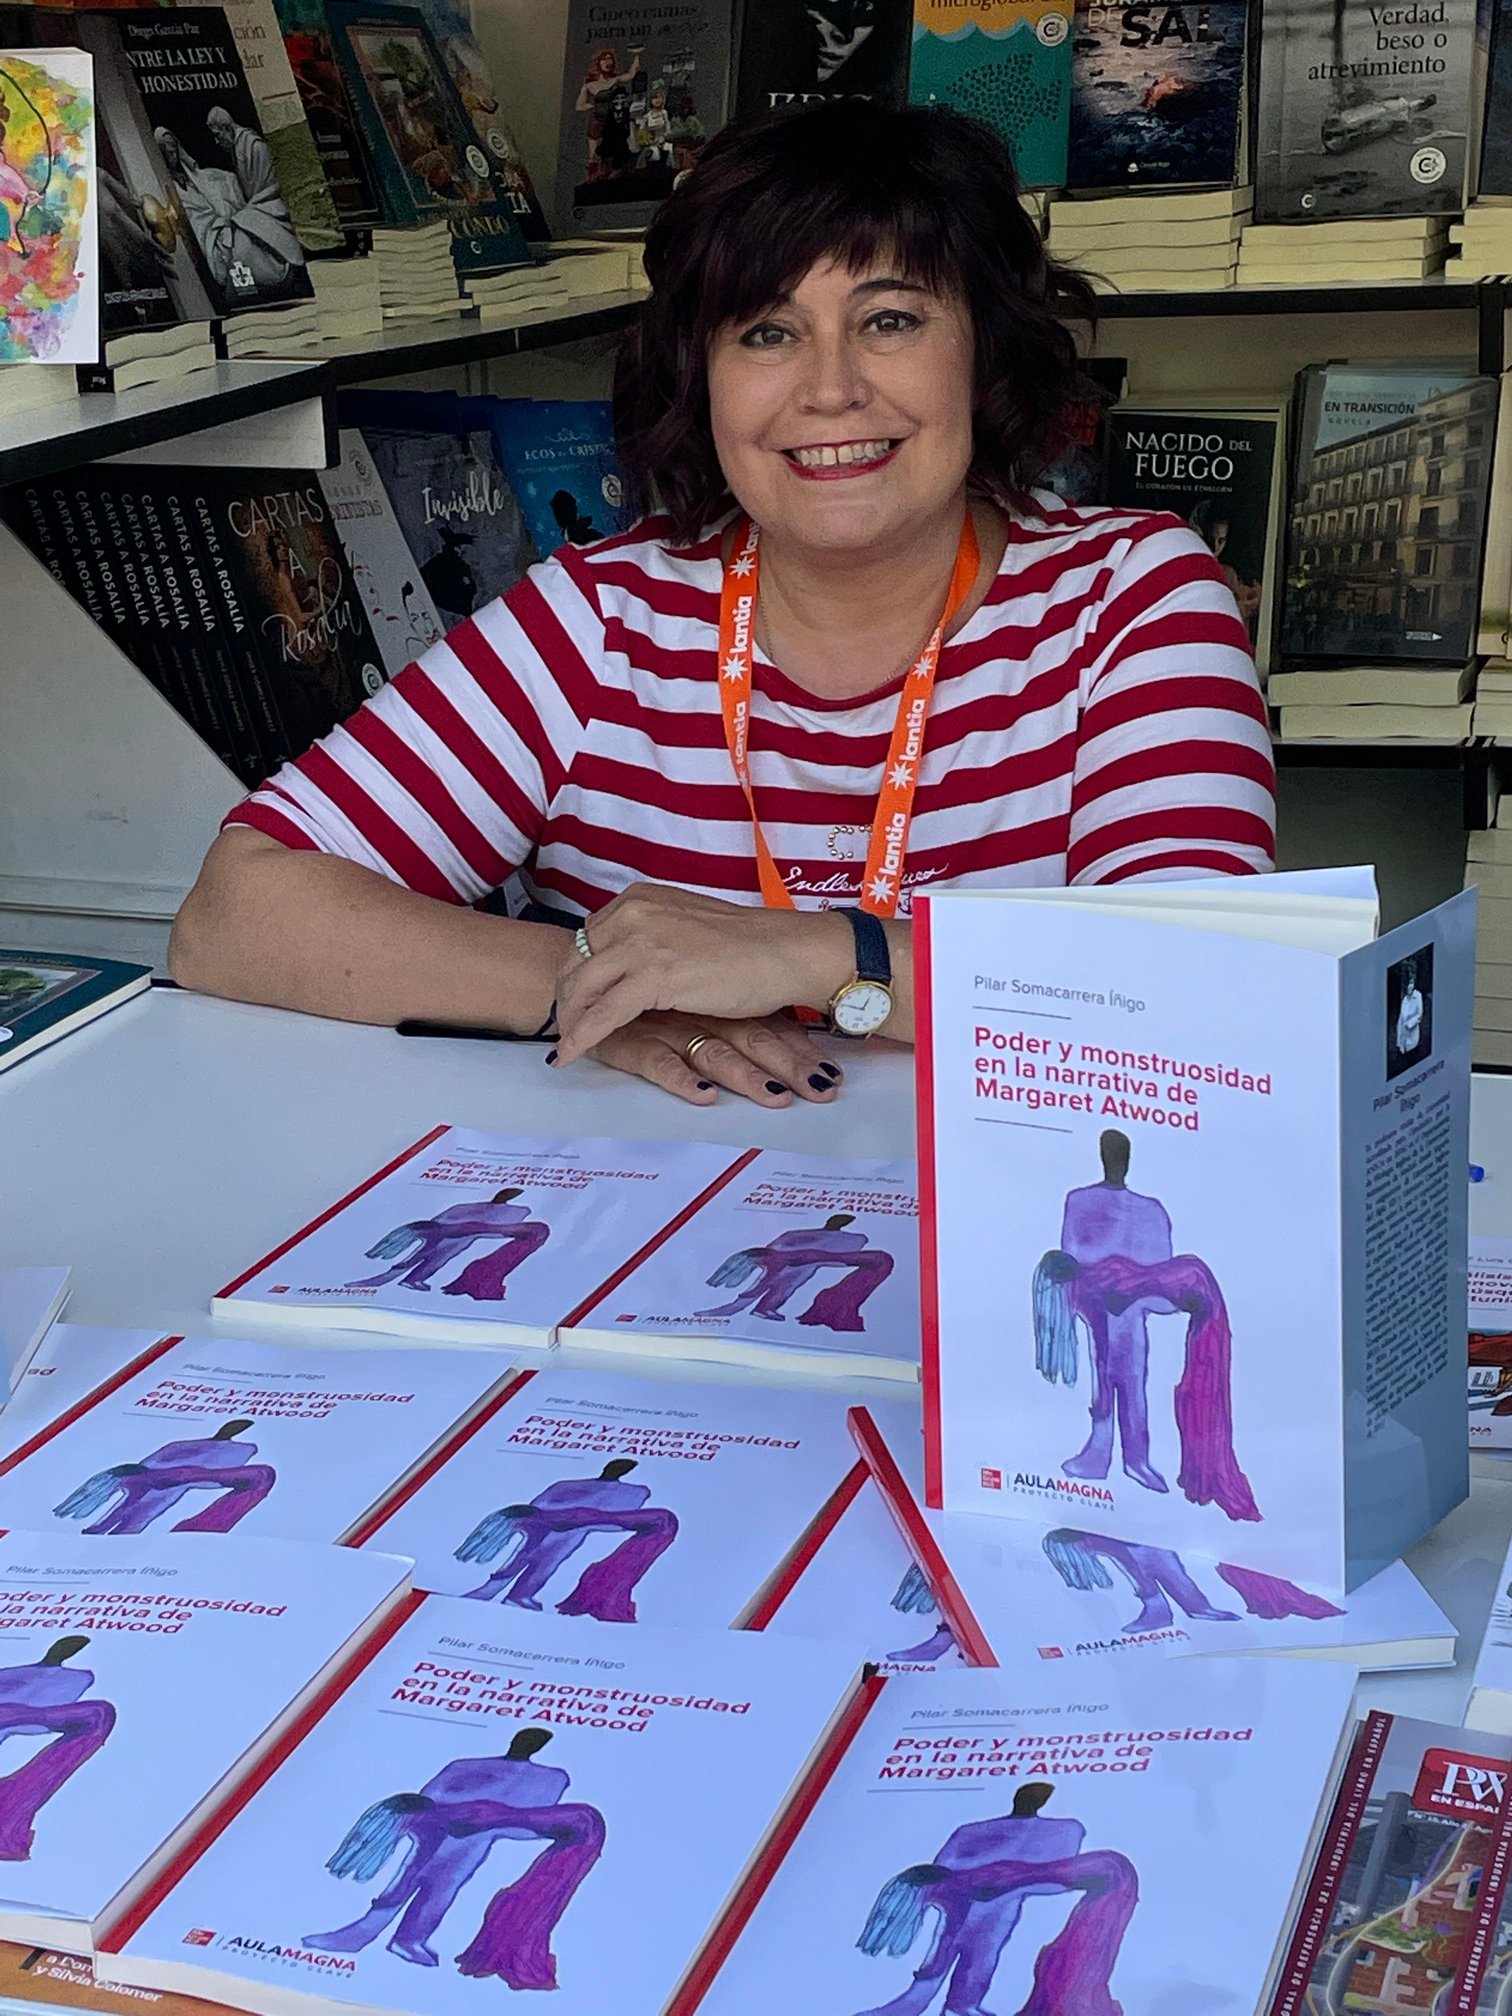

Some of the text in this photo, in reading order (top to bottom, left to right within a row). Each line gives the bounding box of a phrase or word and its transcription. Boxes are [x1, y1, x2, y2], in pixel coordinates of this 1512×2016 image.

[1376, 30, 1448, 51] beso o
[1308, 55, 1446, 81] atrevimiento
[140, 71, 238, 94] HONESTIDAD
[1324, 400, 1415, 414] EN TRANSICIÓN
[1125, 431, 1253, 453] NACIDO DEL
[1134, 453, 1234, 481] FUEGO
[421, 470, 504, 525] Invisible
[100, 491, 126, 547] CARTAS
[118, 550, 130, 560] A
[227, 487, 324, 538] CARTAS
[120, 493, 146, 549] CARTAS
[139, 553, 150, 563] A
[141, 494, 167, 551] CARTAS
[159, 554, 170, 564] A
[167, 495, 192, 552] CARTAS
[184, 555, 195, 566] A
[194, 497, 221, 554] CARTAS
[212, 557, 224, 567] A
[288, 548, 306, 579] A
[730, 595, 753, 654] lantia
[902, 698, 926, 762] lantia
[879, 812, 906, 875] lantia
[974, 975, 1146, 1013] Pilar Somacarrera Íñigo
[974, 1026, 1272, 1096] Poder y monstruosidad
[975, 1056, 1199, 1106] en la narrativa de
[975, 1077, 1199, 1131] Margaret Atwood
[419, 1172, 589, 1190] Margaret Atwood
[428, 1167, 452, 1175] en
[478, 1170, 565, 1182] narrativa
[569, 1174, 595, 1183] de
[437, 1159, 491, 1171] Poder
[513, 1165, 660, 1181] monstruosidad
[750, 1191, 893, 1208] en la narrativa
[756, 1183, 831, 1197] Poder y
[743, 1197, 836, 1211] Margaret
[146, 1391, 339, 1410] en la narrativa de
[157, 1380, 415, 1404] Poder y monstruosidad
[134, 1398, 331, 1420] Margaret Atwood
[515, 1425, 722, 1452] en la narrativa de
[524, 1415, 801, 1450] Poder y monstruosidad
[506, 1433, 717, 1462] Margaret Atwood
[1013, 1472, 1114, 1502] AULAMAGNA
[5, 1564, 40, 1575] Pilar
[43, 1566, 137, 1576] Somacarrera
[1, 1603, 193, 1622] la narrativa de
[60, 1593, 288, 1618] y monstruosidad
[74, 1617, 184, 1635] Atwood
[438, 1636, 475, 1651] Pilar
[477, 1642, 580, 1667] Somacarrera
[1075, 1629, 1189, 1652] AULAMAGNA
[402, 1676, 656, 1719] en la narrativa de
[413, 1661, 752, 1715] Poder y monstruosidad
[391, 1687, 649, 1734] Margaret Atwood
[910, 1707, 949, 1720] Pilar
[951, 1704, 1062, 1719] Somacarrera
[893, 1727, 1254, 1752] Poder y monstruosidad
[885, 1743, 1154, 1766] en la narrativa de
[877, 1758, 1151, 1781] Margaret Atwood
[1430, 1794, 1452, 1805] EN
[1485, 1896, 1495, 1909] LA
[1480, 1913, 1492, 1925] DE
[228, 1935, 356, 1973] AULAMAGNA
[1463, 1930, 1487, 1992] REFERENCIA
[32, 1964, 163, 2002] y Silvia Colomer
